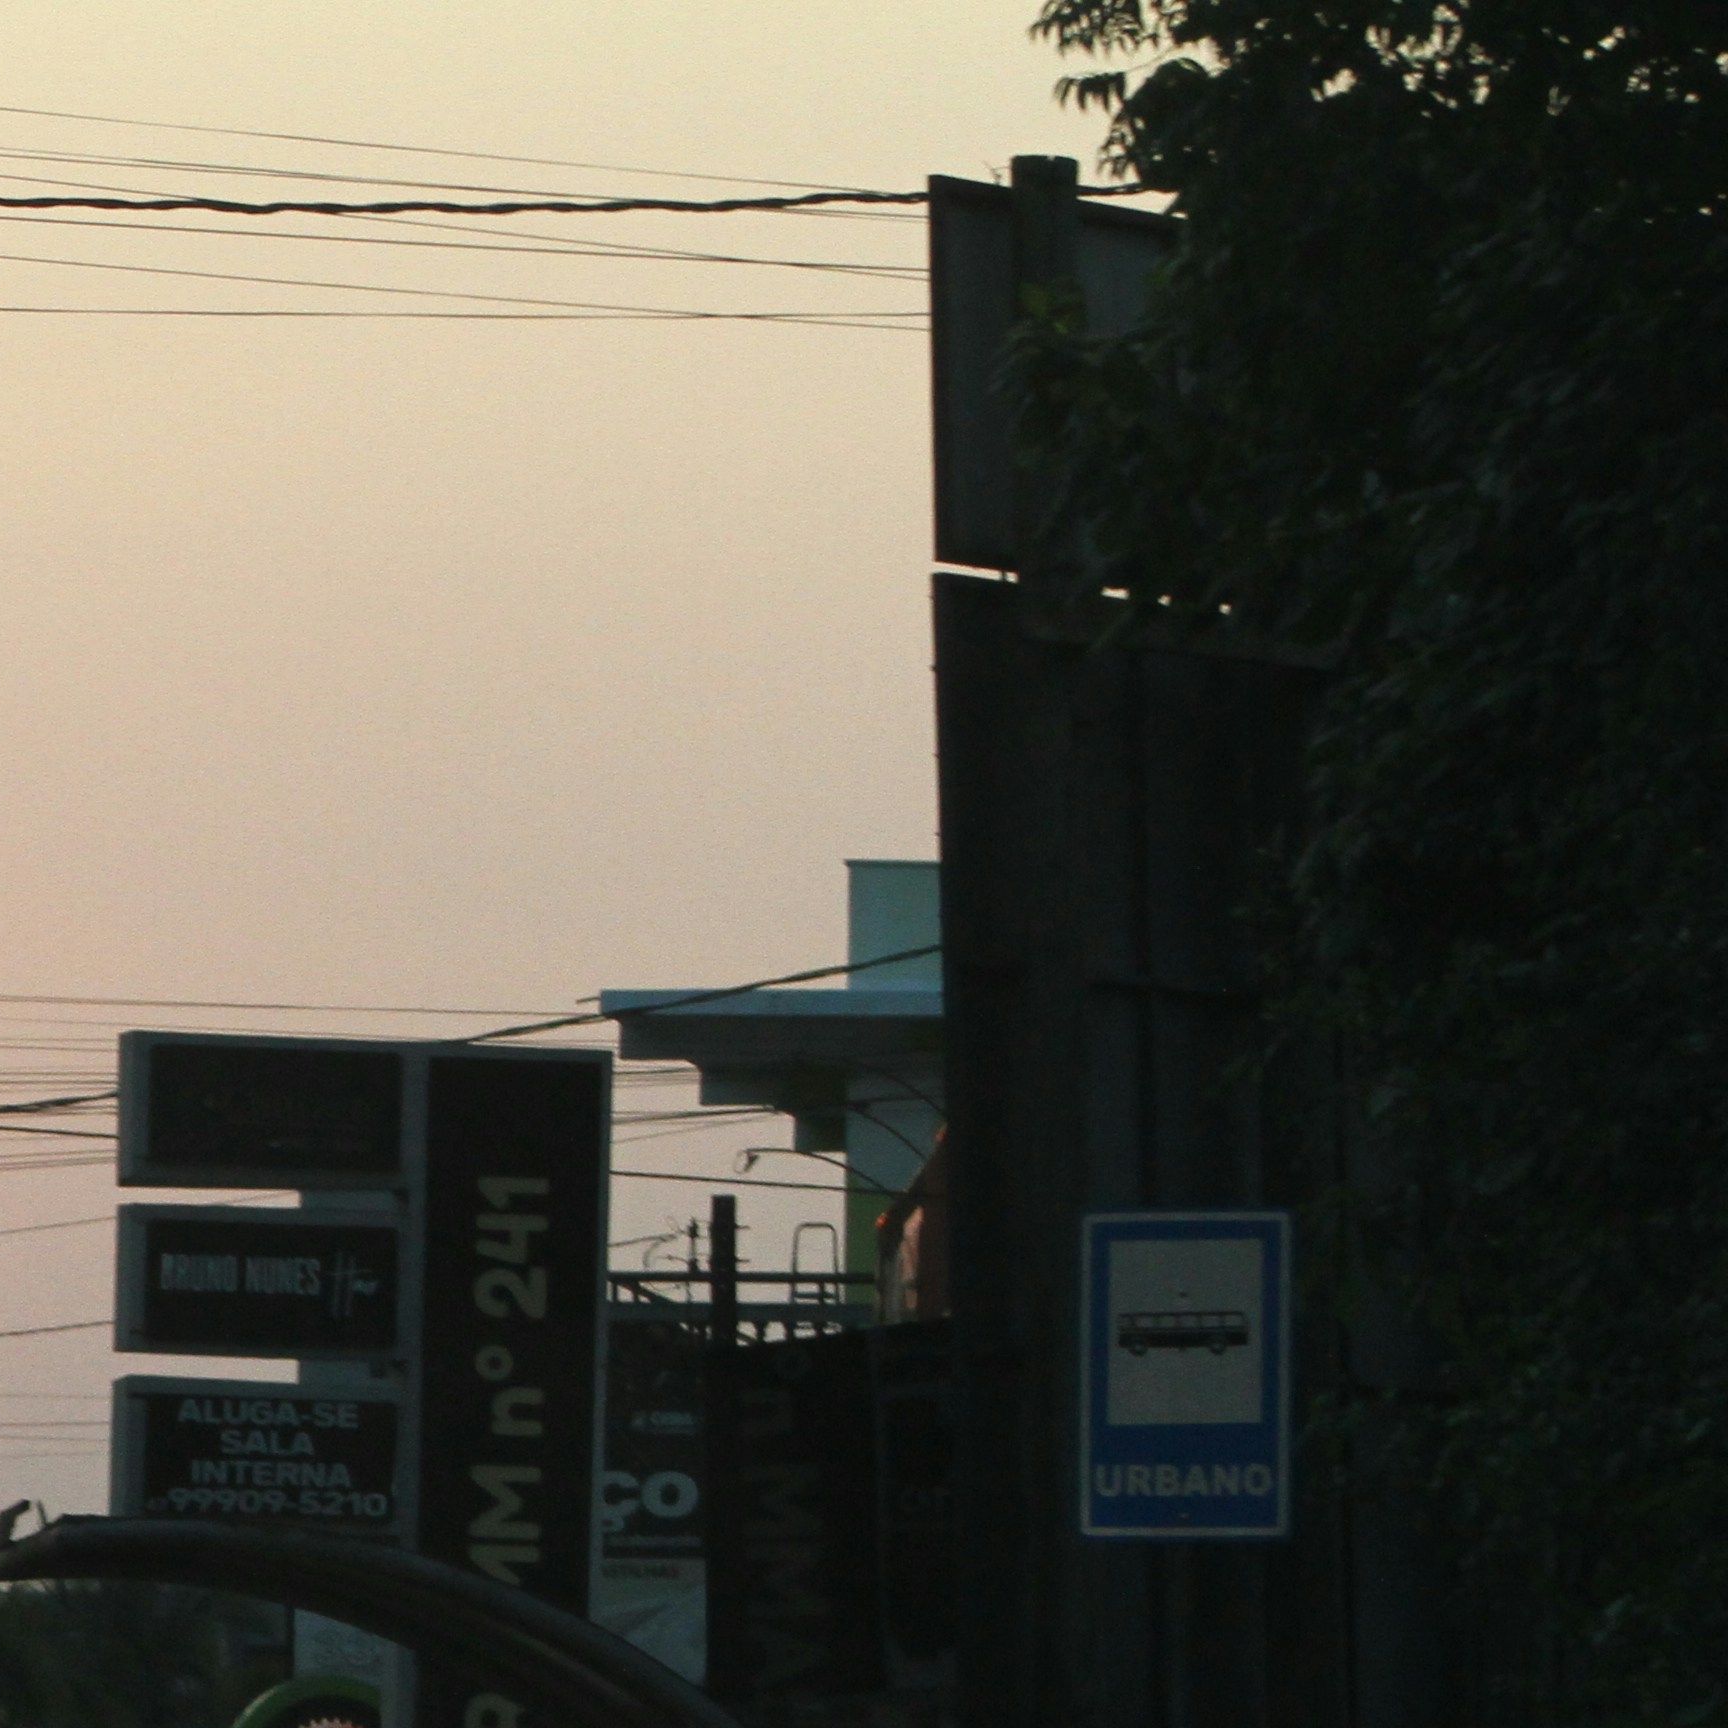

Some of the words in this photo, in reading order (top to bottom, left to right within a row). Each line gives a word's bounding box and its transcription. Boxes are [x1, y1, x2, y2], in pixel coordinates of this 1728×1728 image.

[473, 1175, 550, 1320] 241
[177, 1398, 359, 1429] ALUGA-SE
[220, 1429, 314, 1456] SALA
[191, 1458, 351, 1488] INTERNA
[1095, 1463, 1274, 1498] URBANO
